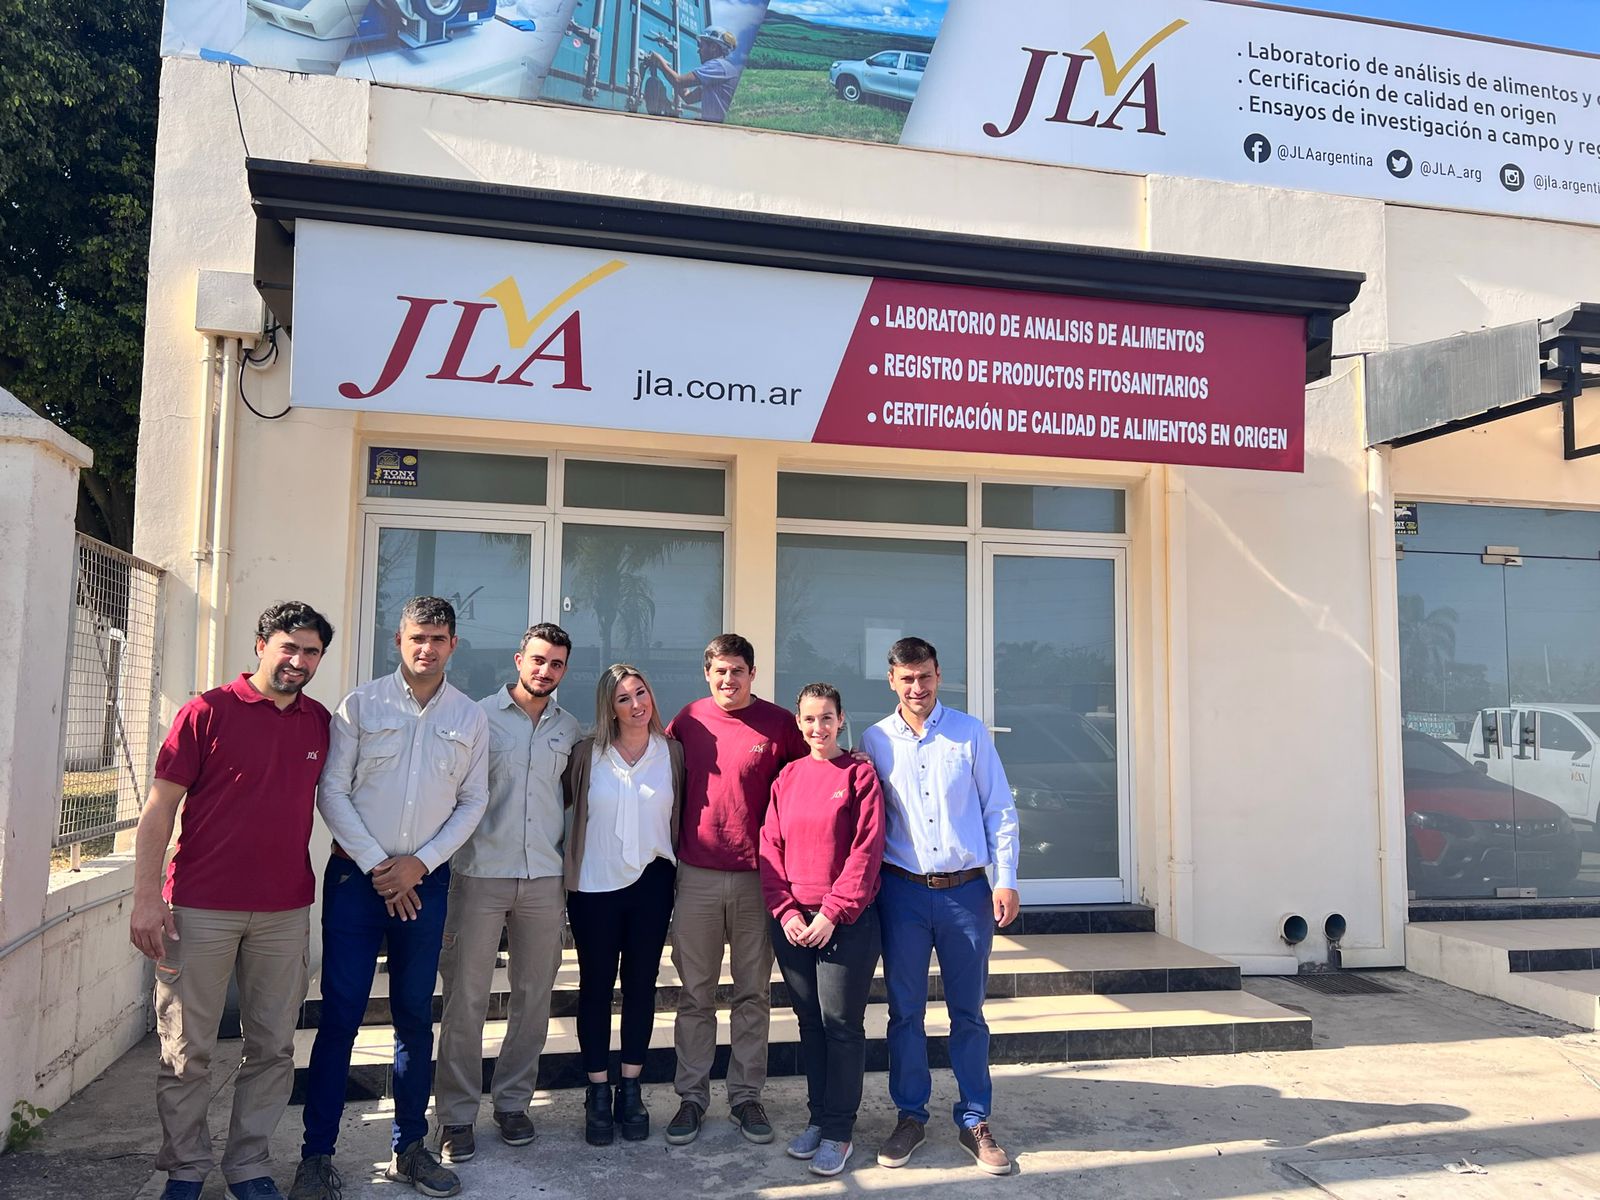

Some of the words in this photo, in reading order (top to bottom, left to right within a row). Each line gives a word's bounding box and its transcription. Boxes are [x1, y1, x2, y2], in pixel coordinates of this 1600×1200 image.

[981, 46, 1167, 138] JLA
[1248, 41, 1360, 72] Laboratorio
[1366, 57, 1389, 75] de
[1394, 63, 1461, 86] análisis
[1466, 72, 1488, 90] de
[1493, 76, 1578, 103] alimentos
[1582, 92, 1592, 108] y
[1248, 69, 1370, 99] Certificación
[1376, 84, 1399, 103] de
[1404, 90, 1468, 113] calidad
[1474, 102, 1495, 116] en
[1500, 104, 1556, 125] origen
[1249, 95, 1327, 121] Ensayos
[1332, 105, 1355, 124] de
[1361, 108, 1482, 140] investigación
[1487, 129, 1497, 142] a
[1502, 131, 1560, 151] campo
[1564, 139, 1573, 155] y
[1277, 144, 1373, 167] @JLAargentina
[1420, 160, 1482, 182] @JLA_arg
[337, 294, 592, 400] JLA
[885, 304, 996, 336] LABORATORIO
[1000, 314, 1020, 338] DE
[1024, 316, 1094, 344] ANALISIS
[1098, 322, 1118, 346] DE
[1121, 325, 1205, 354] ALIMENTOS
[633, 369, 803, 406] jla.com.ar
[884, 353, 963, 382] REGISTRO
[968, 359, 988, 383] DE
[992, 361, 1084, 390] PRODUCTOS
[1088, 368, 1209, 400] FITOSANITARIOS
[882, 401, 1003, 431] CERTIFICACIÓN
[1007, 409, 1027, 433] DE
[1031, 411, 1097, 437] CALIDAD
[1100, 415, 1120, 439] DE
[1123, 417, 1207, 445] ALIMENTOS
[1210, 423, 1230, 446] EN
[1234, 425, 1288, 450] ORIGEN
